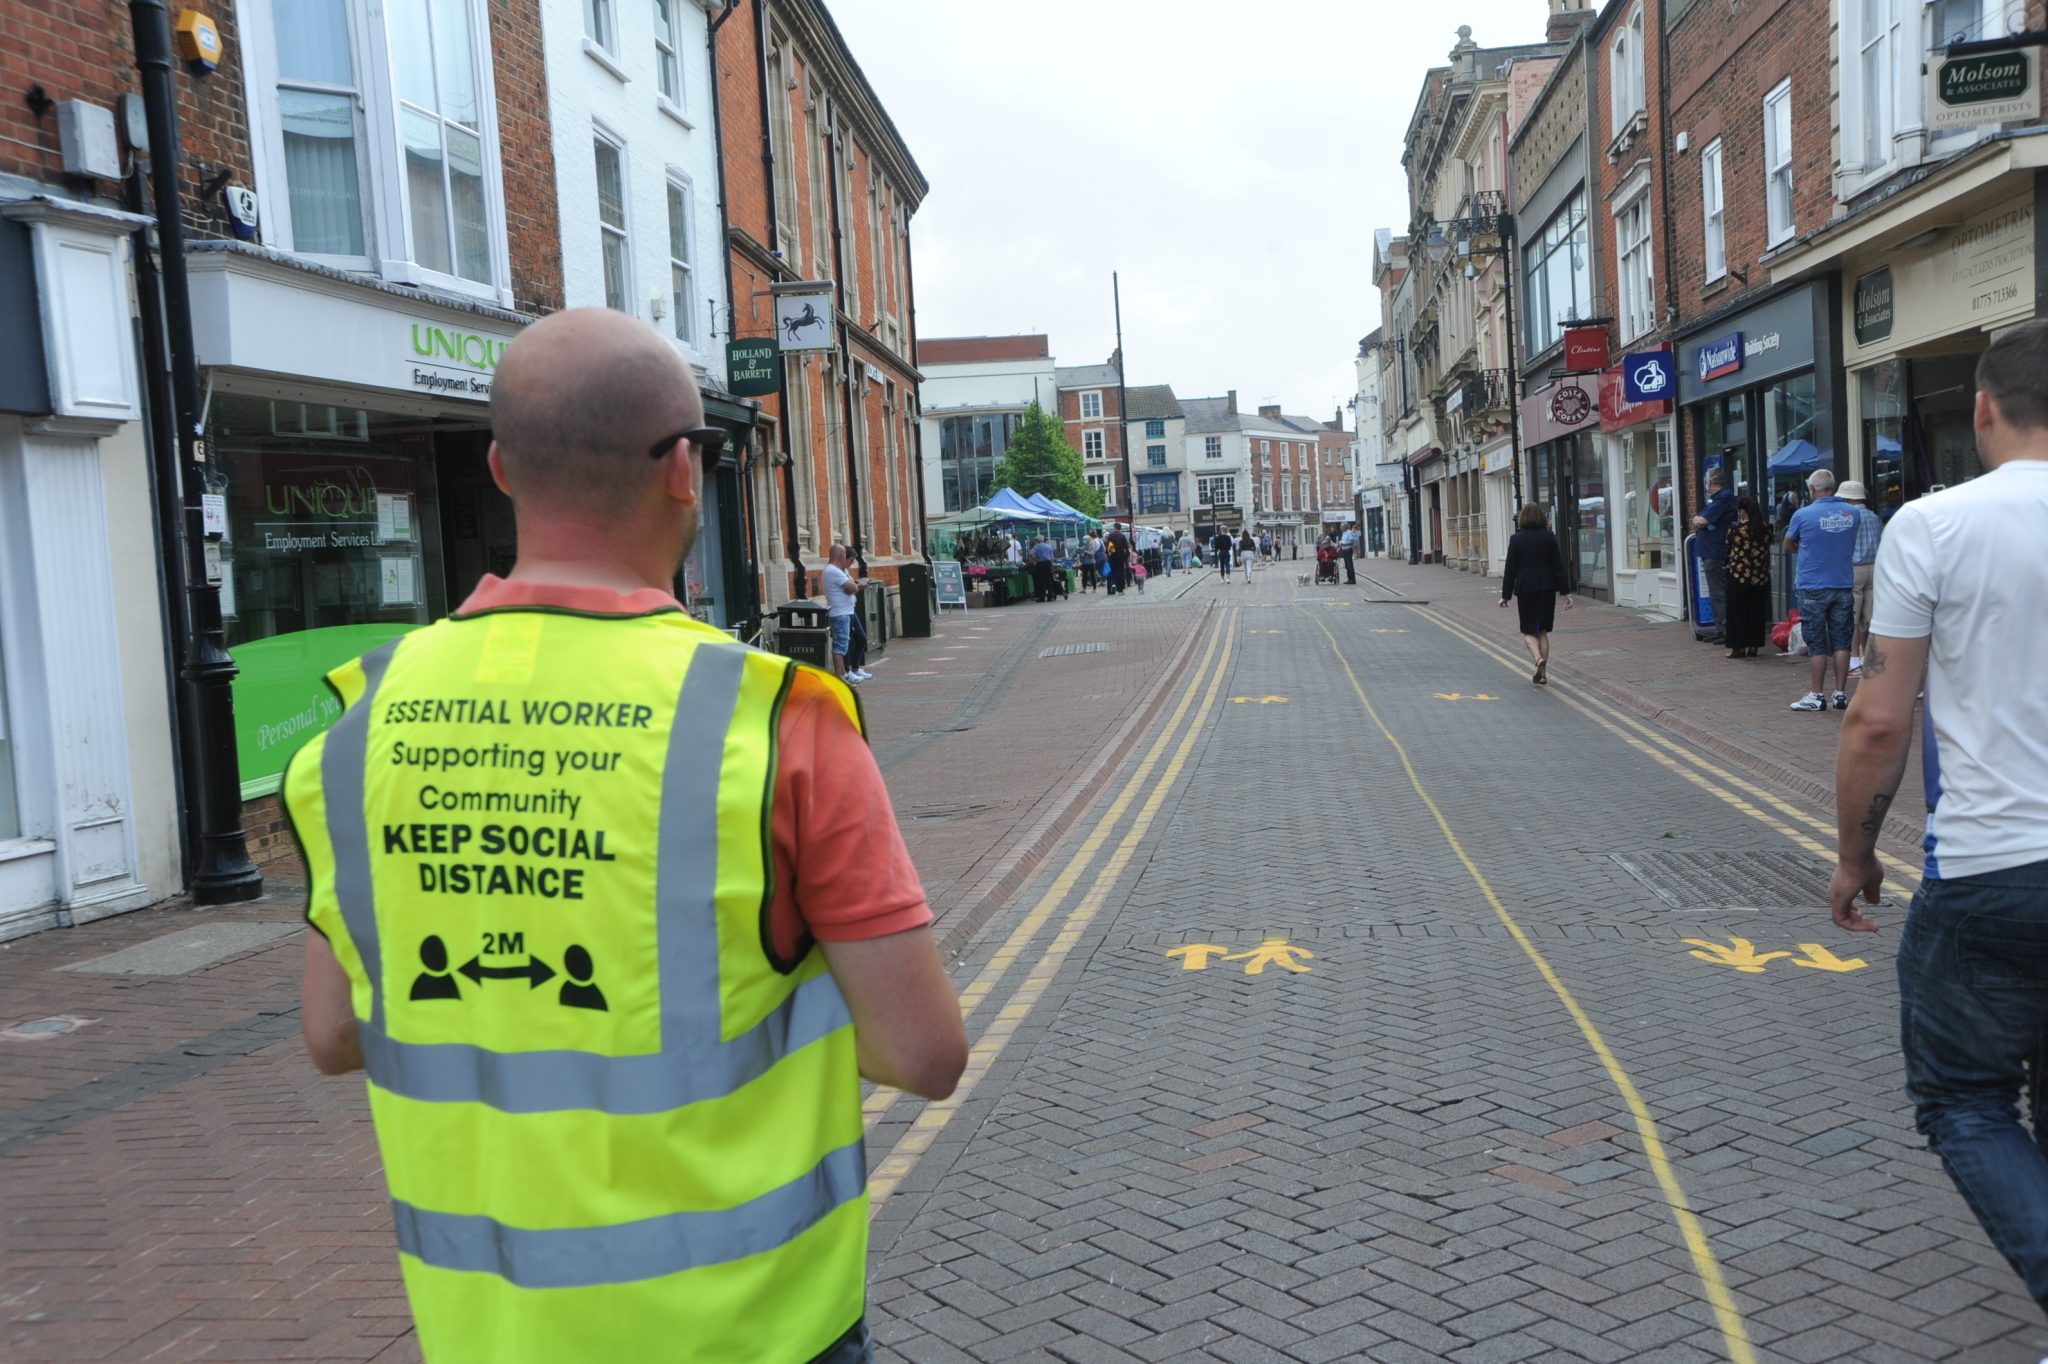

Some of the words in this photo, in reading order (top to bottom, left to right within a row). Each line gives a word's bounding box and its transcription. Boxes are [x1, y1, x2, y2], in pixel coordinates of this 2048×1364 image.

[1946, 63, 2020, 85] Molsom
[1946, 88, 1954, 96] &
[1957, 79, 2021, 95] ASSOCIATES
[1936, 102, 2032, 121] OPTOMETRISTS
[1952, 203, 2034, 255] OPTOMETRIS
[1952, 264, 1978, 284] CONTACT
[1979, 259, 1993, 274] LENS
[1994, 243, 2034, 267] PRACTITION
[1857, 285, 1890, 314] Molsom
[1972, 292, 1991, 310] 01775
[1993, 283, 2018, 303] 713366
[1863, 309, 1891, 328] Associates
[412, 323, 508, 369] UNIQU
[732, 348, 772, 361] HOLLAND
[1706, 341, 1736, 370] Nationwide
[1744, 338, 1763, 357] Building
[1763, 332, 1779, 350] Society
[733, 368, 773, 381] BARRETT
[748, 359, 757, 369] &
[414, 368, 468, 391] Employment
[1558, 390, 1582, 400] COSTA
[1557, 409, 1586, 421] COFFEE
[265, 485, 377, 518] UNIQUE
[265, 532, 326, 552] Employment
[331, 531, 369, 548] Services
[371, 531, 385, 546] Ltd
[257, 694, 318, 751] Personal
[384, 699, 511, 724] ESSENTIAL
[522, 701, 653, 728] WORKER
[392, 741, 545, 776] Supporting
[555, 750, 621, 776] your
[419, 785, 581, 820] Community
[383, 823, 472, 855] KEEP
[479, 824, 616, 861] SOCIAL
[418, 863, 584, 900] DISTANCE
[481, 932, 524, 955] 2M
